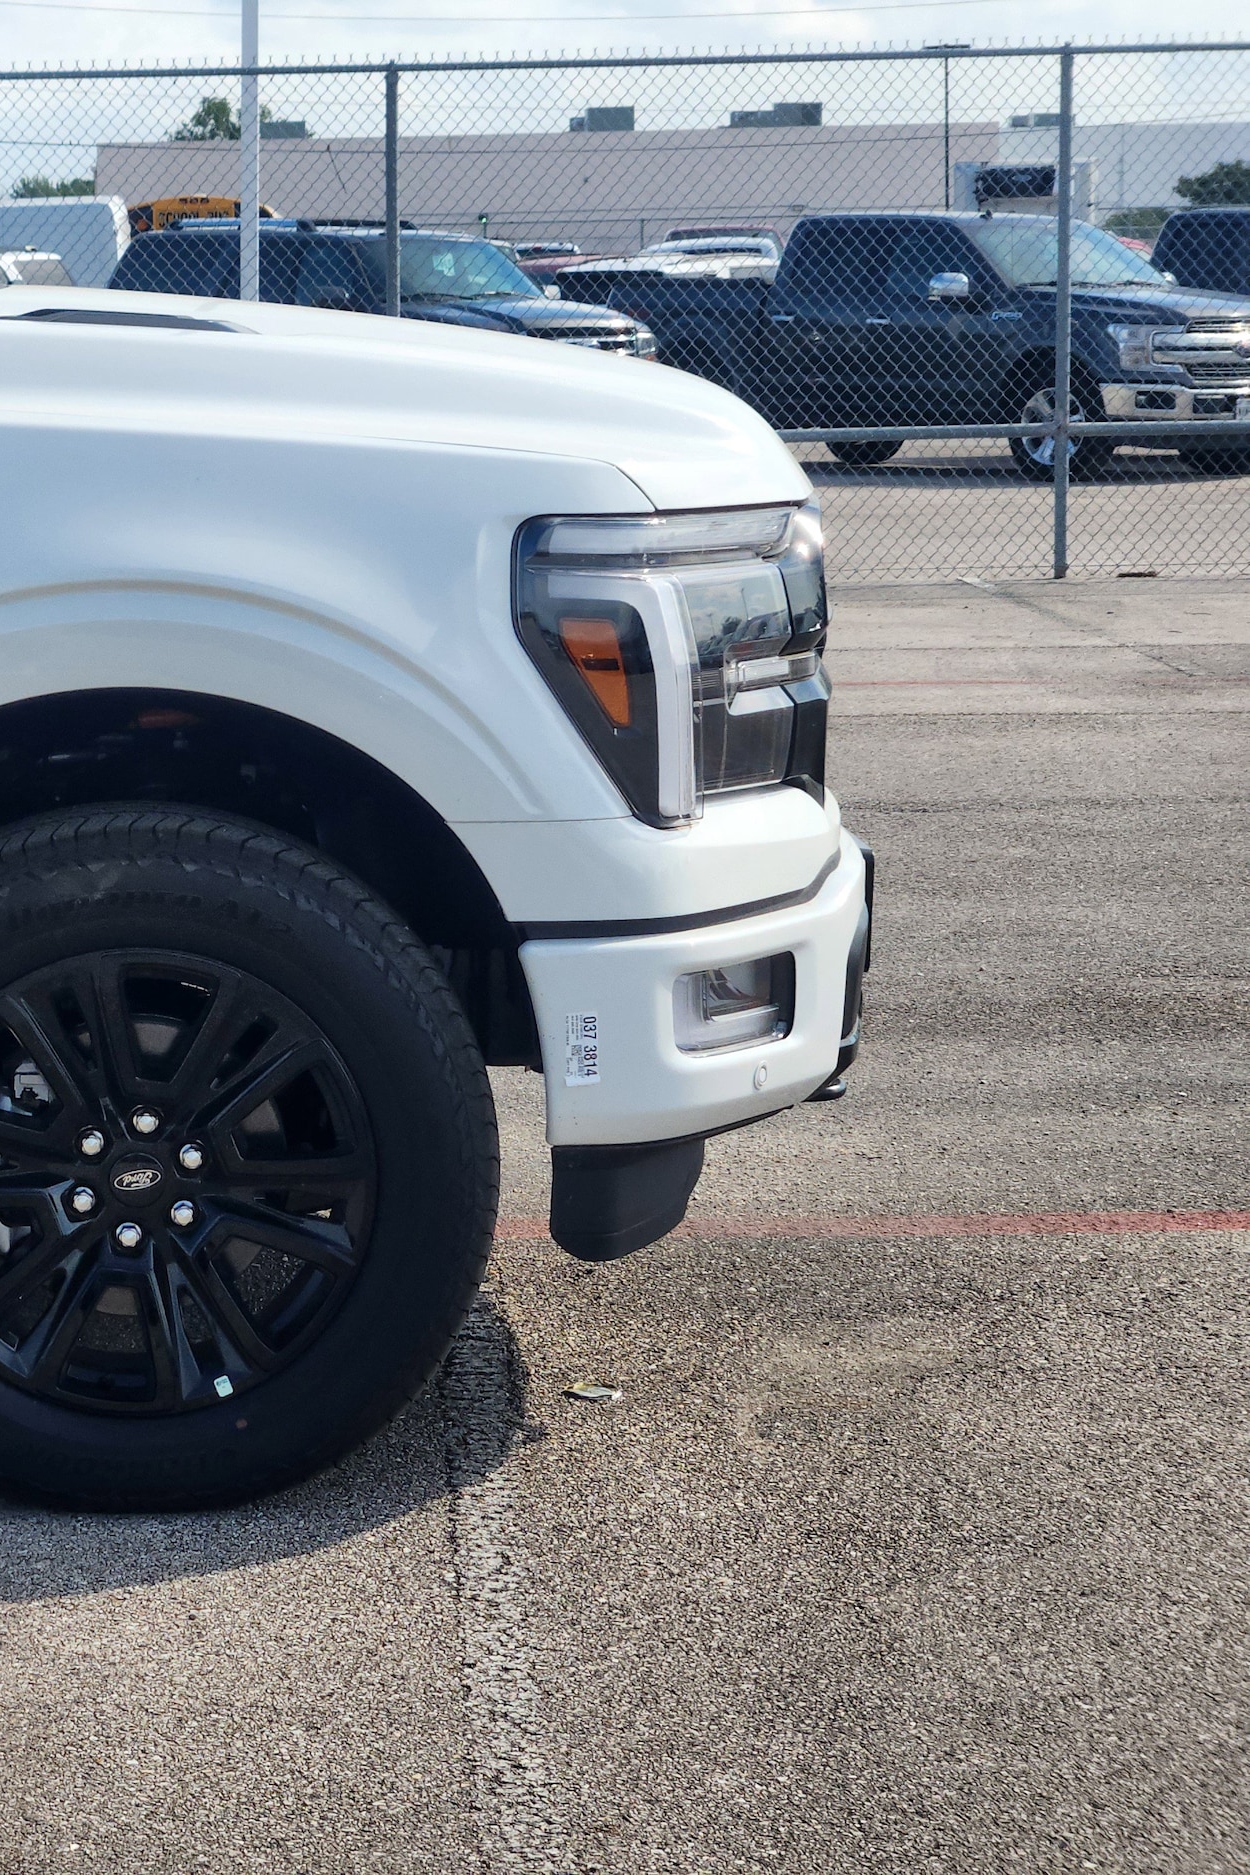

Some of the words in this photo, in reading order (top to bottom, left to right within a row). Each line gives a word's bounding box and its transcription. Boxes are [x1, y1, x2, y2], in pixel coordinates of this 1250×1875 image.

[583, 1016, 597, 1040] 037
[583, 1045, 598, 1077] 3814
[122, 1171, 153, 1188] Ford
